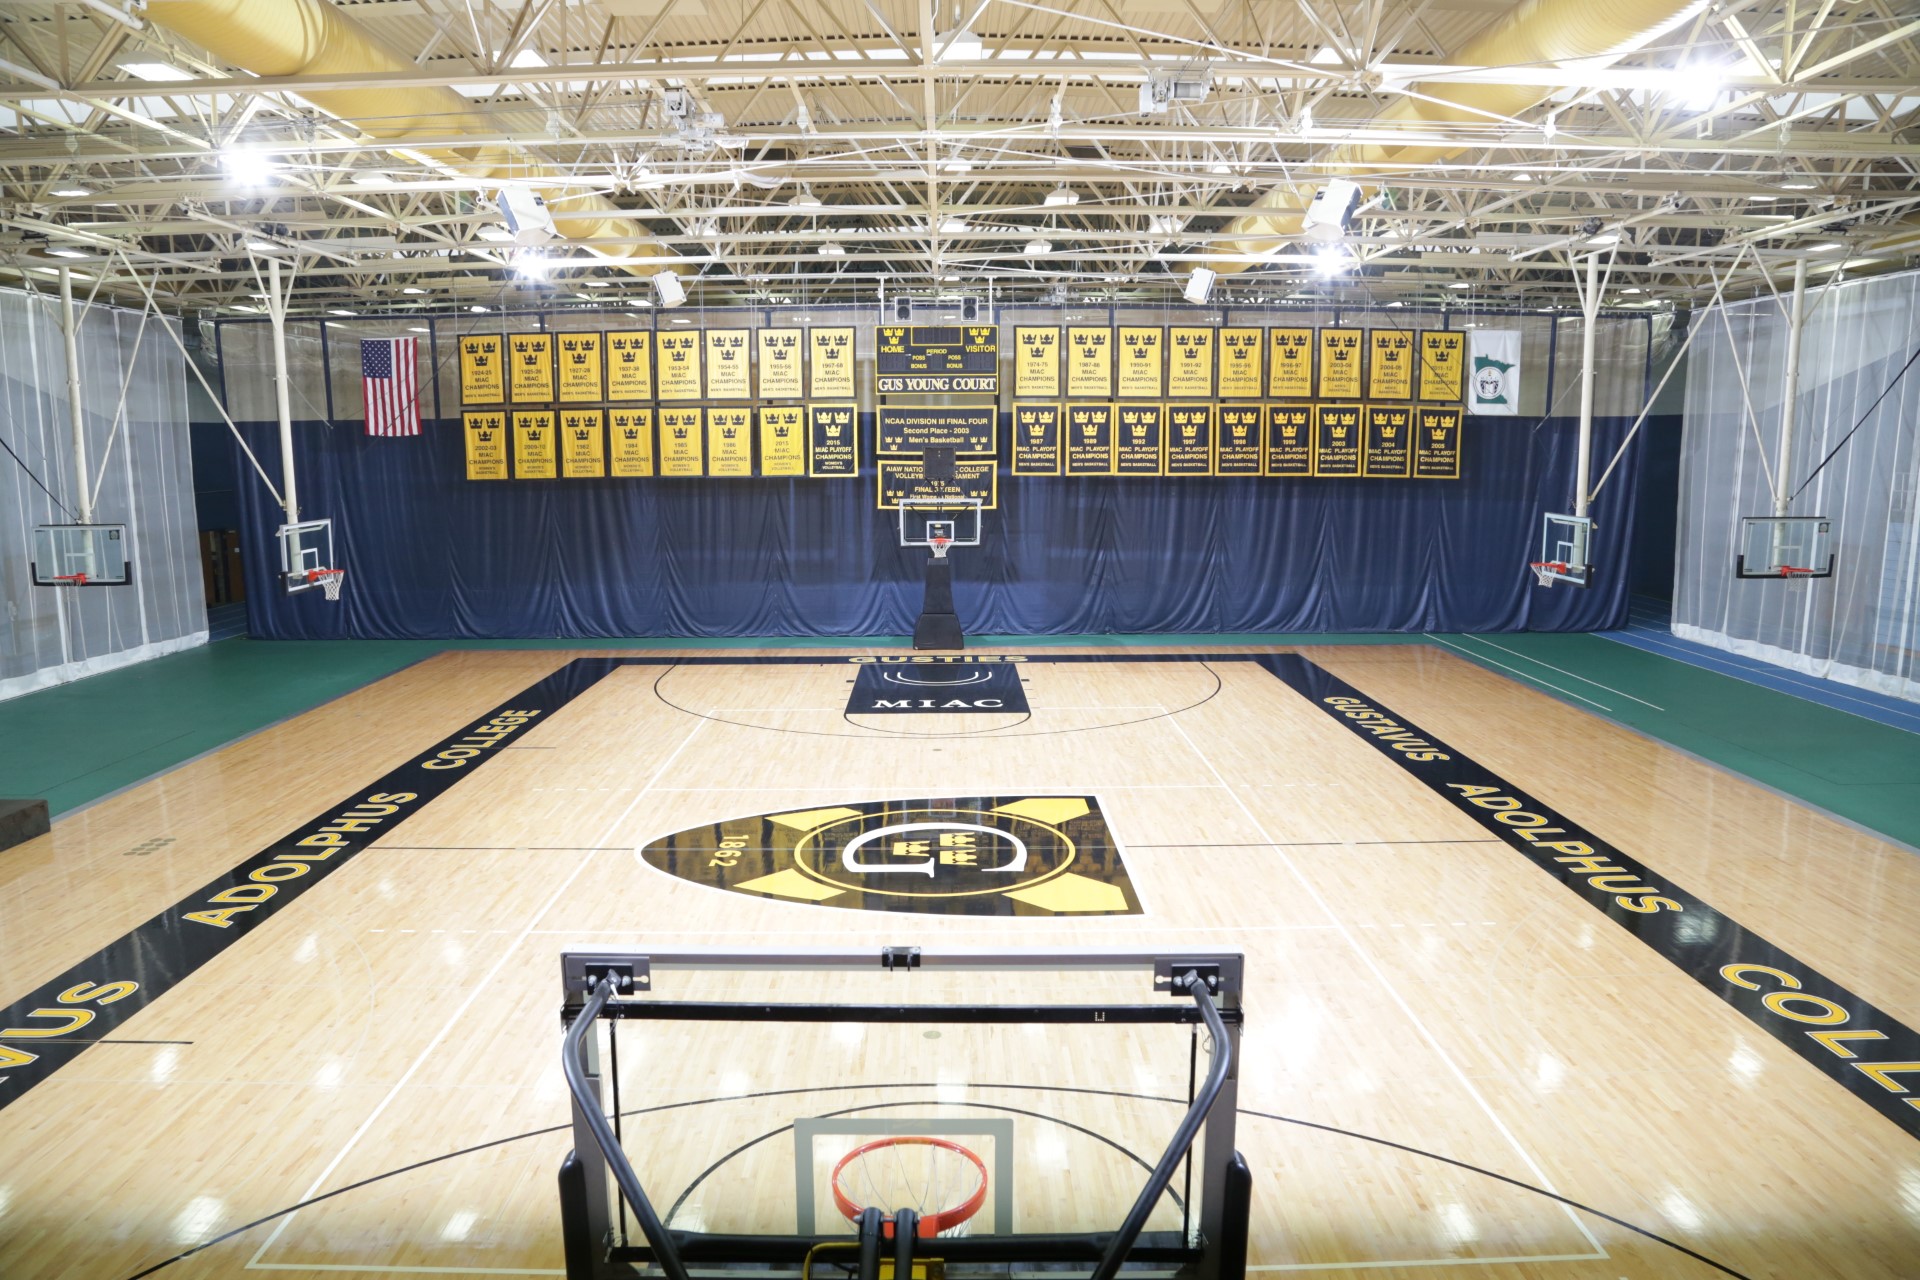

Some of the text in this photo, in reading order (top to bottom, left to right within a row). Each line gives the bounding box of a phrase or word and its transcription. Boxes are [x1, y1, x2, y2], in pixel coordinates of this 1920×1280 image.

[878, 378, 996, 391] GUS YOUNG COURT
[871, 699, 1004, 708] MIAC
[181, 791, 418, 929] ADOLPHUS
[421, 709, 541, 770] COLLEGE
[708, 834, 749, 867] 1862
[1323, 696, 1920, 1112] GUSTAVUS ADOLPHUS COLL
